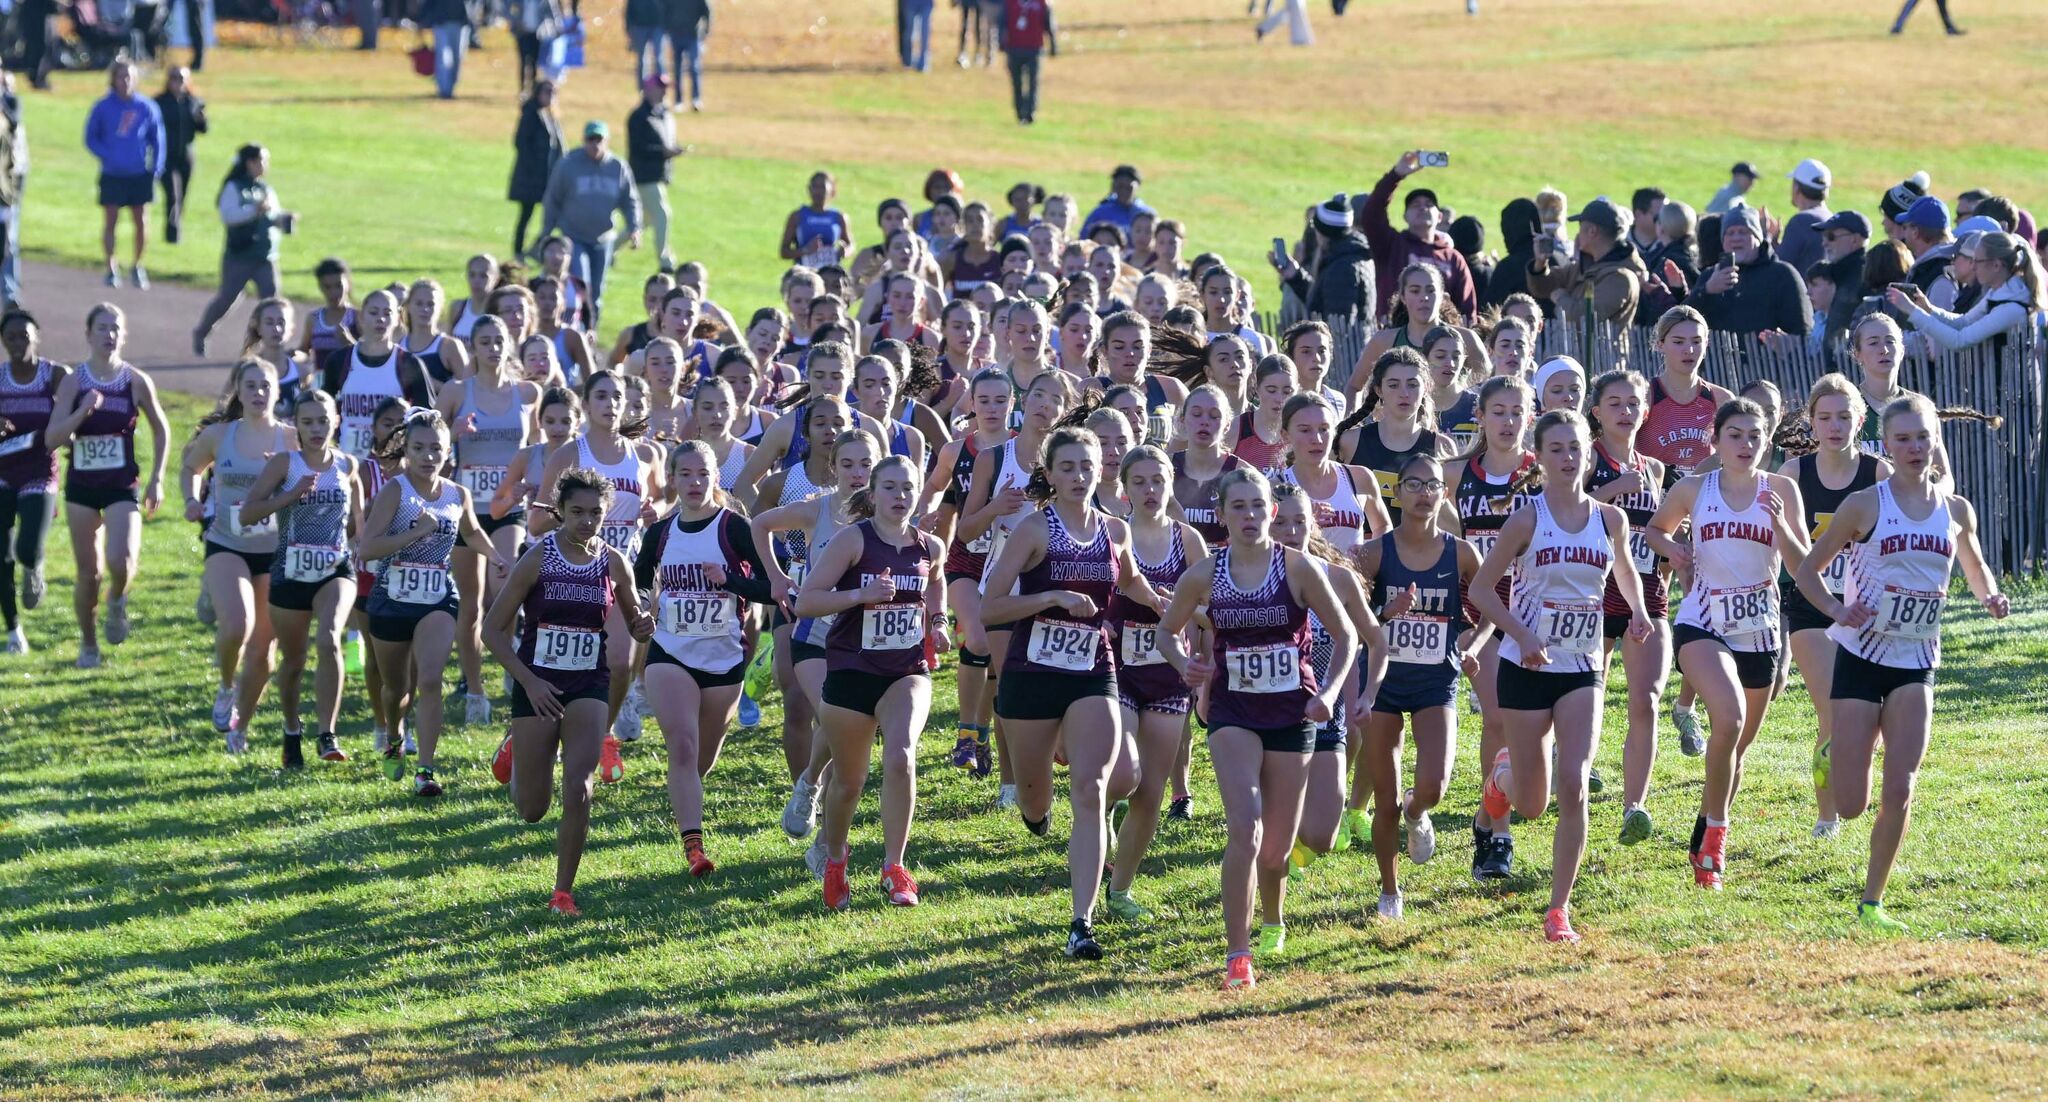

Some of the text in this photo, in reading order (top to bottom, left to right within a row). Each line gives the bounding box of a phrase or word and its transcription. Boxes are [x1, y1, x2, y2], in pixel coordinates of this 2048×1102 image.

[81, 440, 117, 459] 1922
[353, 430, 372, 449] 18
[600, 526, 629, 549] 882
[1630, 533, 1650, 560] 46
[1700, 521, 1773, 547] NEW CANAAN
[1880, 534, 1908, 556] NEW
[293, 549, 335, 571] 1909
[1536, 546, 1607, 570] NEW CANAAN
[398, 568, 441, 592] 1910
[674, 599, 723, 624] 1872
[1386, 585, 1449, 612] PATT
[1719, 589, 1769, 621] 1883
[1891, 595, 1940, 625] 1878
[872, 609, 918, 637] 1854
[1212, 605, 1289, 629] WINDSOR
[1550, 611, 1598, 639] 1879
[545, 631, 594, 658] 1918
[1041, 625, 1093, 657] 1924
[1132, 629, 1156, 653] 19
[1386, 621, 1440, 650] 1898
[1236, 650, 1292, 680] 1919
